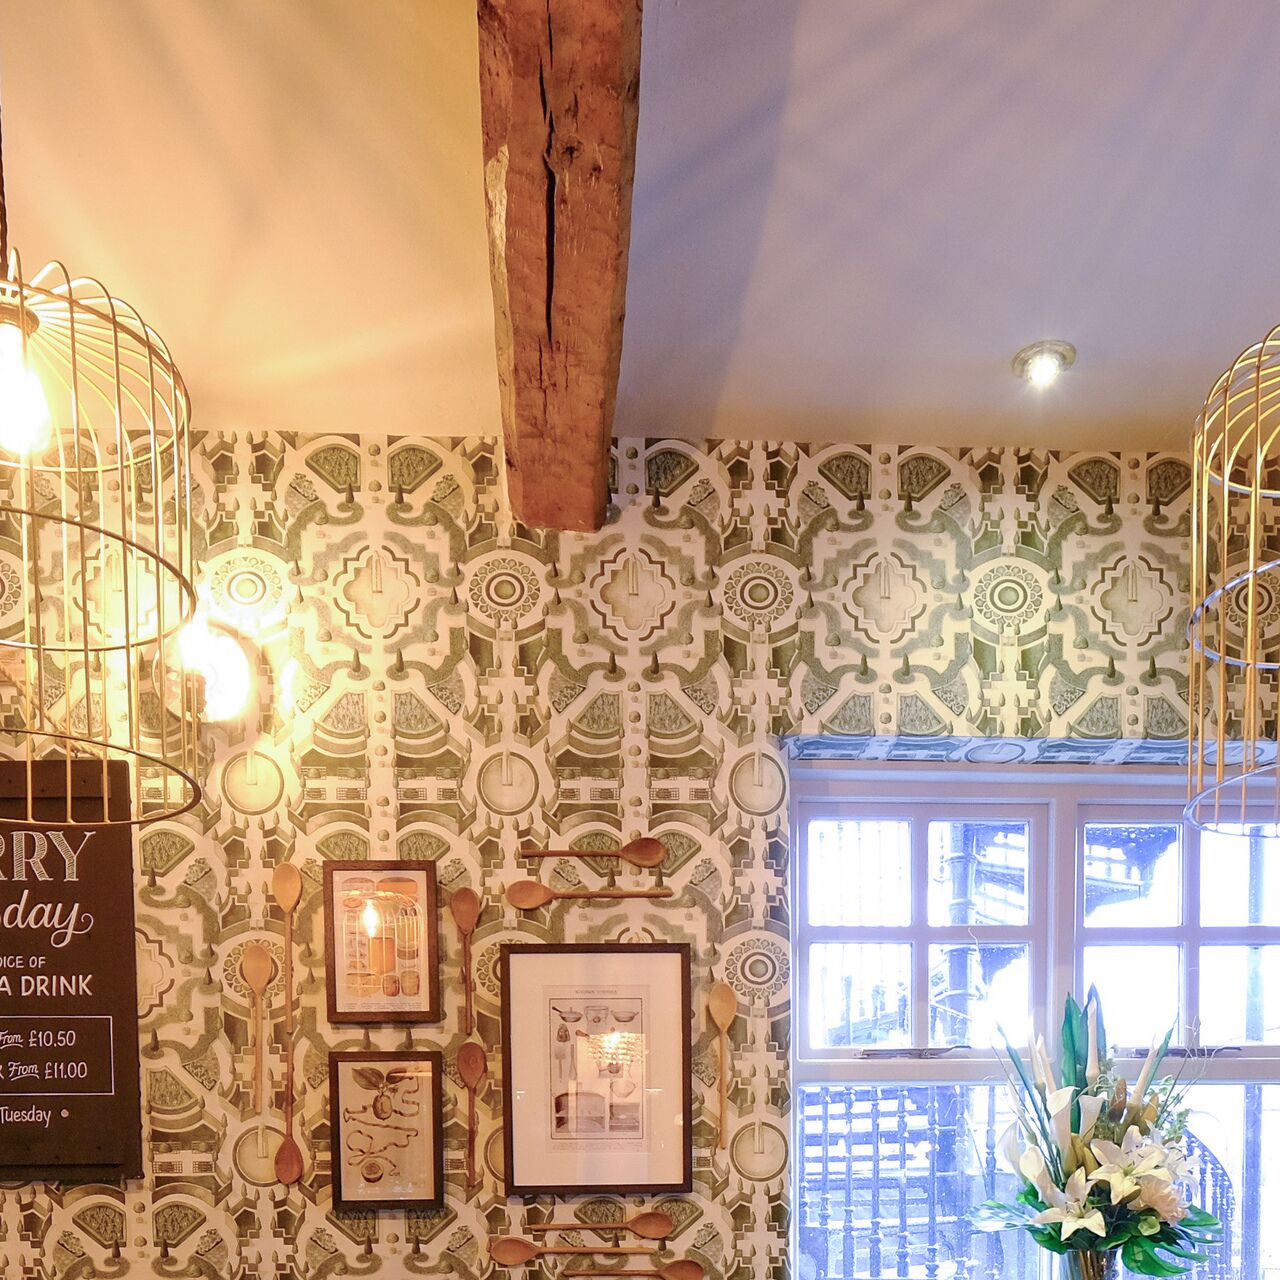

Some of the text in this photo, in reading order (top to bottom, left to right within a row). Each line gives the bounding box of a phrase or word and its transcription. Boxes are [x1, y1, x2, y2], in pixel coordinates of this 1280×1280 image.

[28, 956, 47, 969] OF
[21, 974, 93, 997] DRINK
[28, 1030, 76, 1048] £10.50
[8, 1061, 39, 1080] From
[44, 1061, 88, 1079] £11.00
